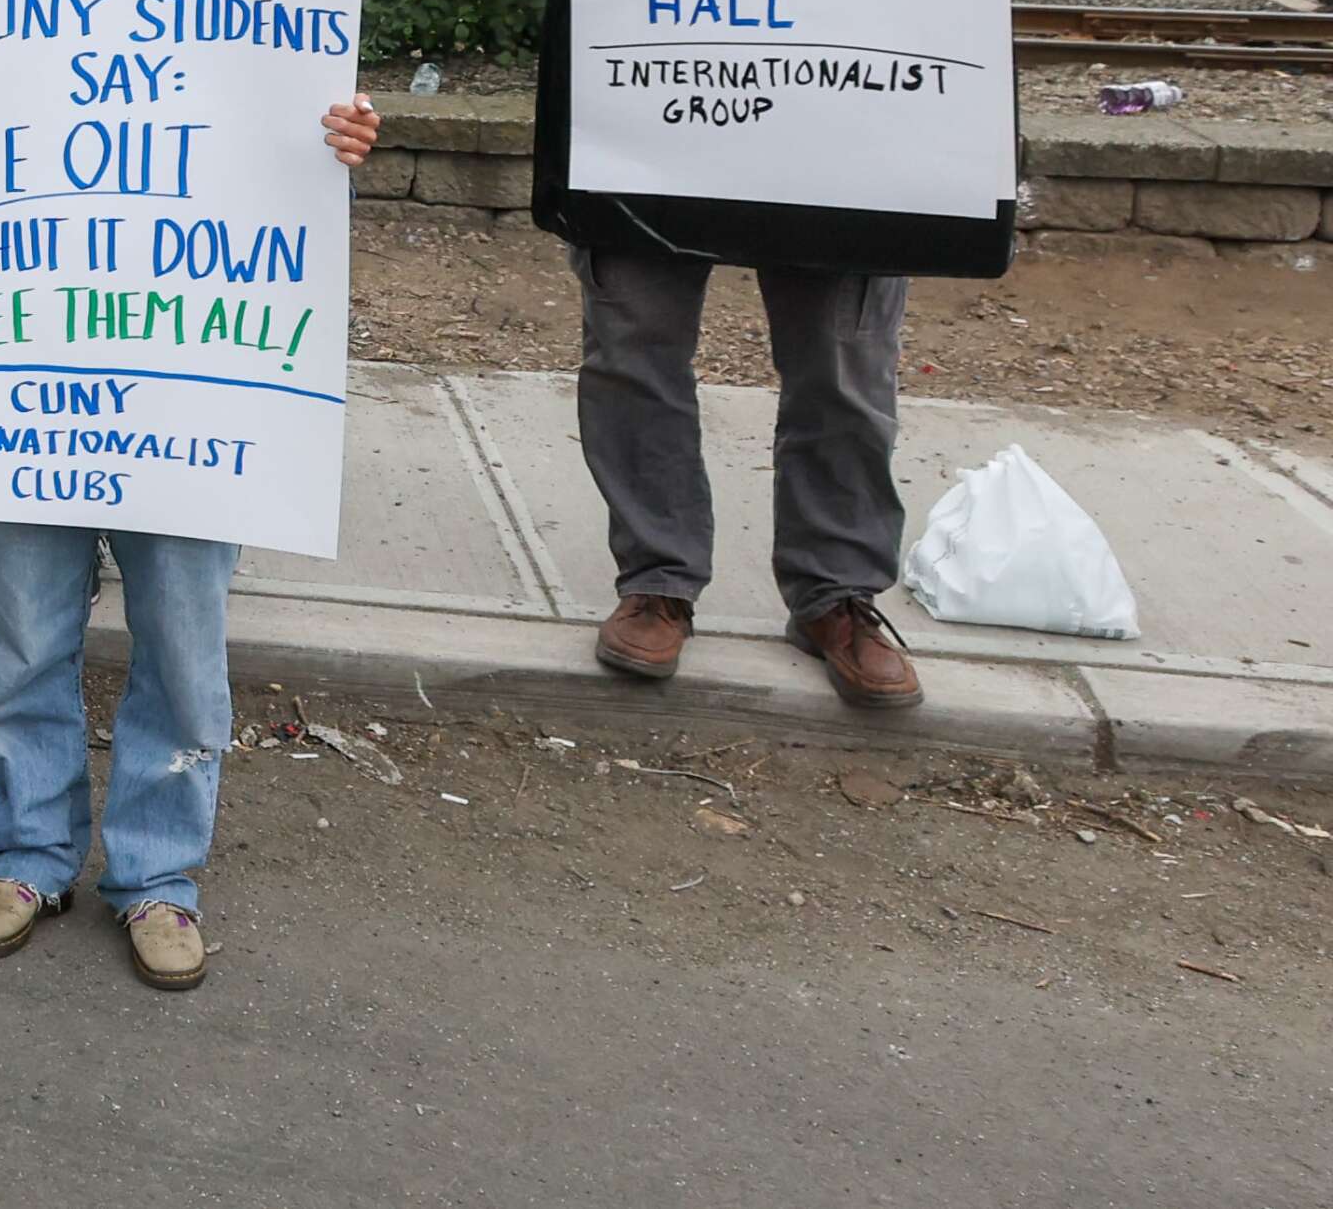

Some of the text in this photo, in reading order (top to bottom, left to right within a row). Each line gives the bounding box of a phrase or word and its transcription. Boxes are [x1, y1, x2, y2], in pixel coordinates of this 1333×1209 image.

[70, 51, 186, 106] SAY:
[605, 58, 947, 94] INTERNATIONALIST
[663, 97, 773, 126] GROUP
[63, 120, 211, 199] OUT
[87, 217, 125, 273] IT
[153, 217, 307, 284] DOWN
[53, 287, 185, 345] THEM
[201, 296, 314, 372] ALL!
[10, 378, 138, 416] CUNY
[12, 466, 131, 506] CLUBS
